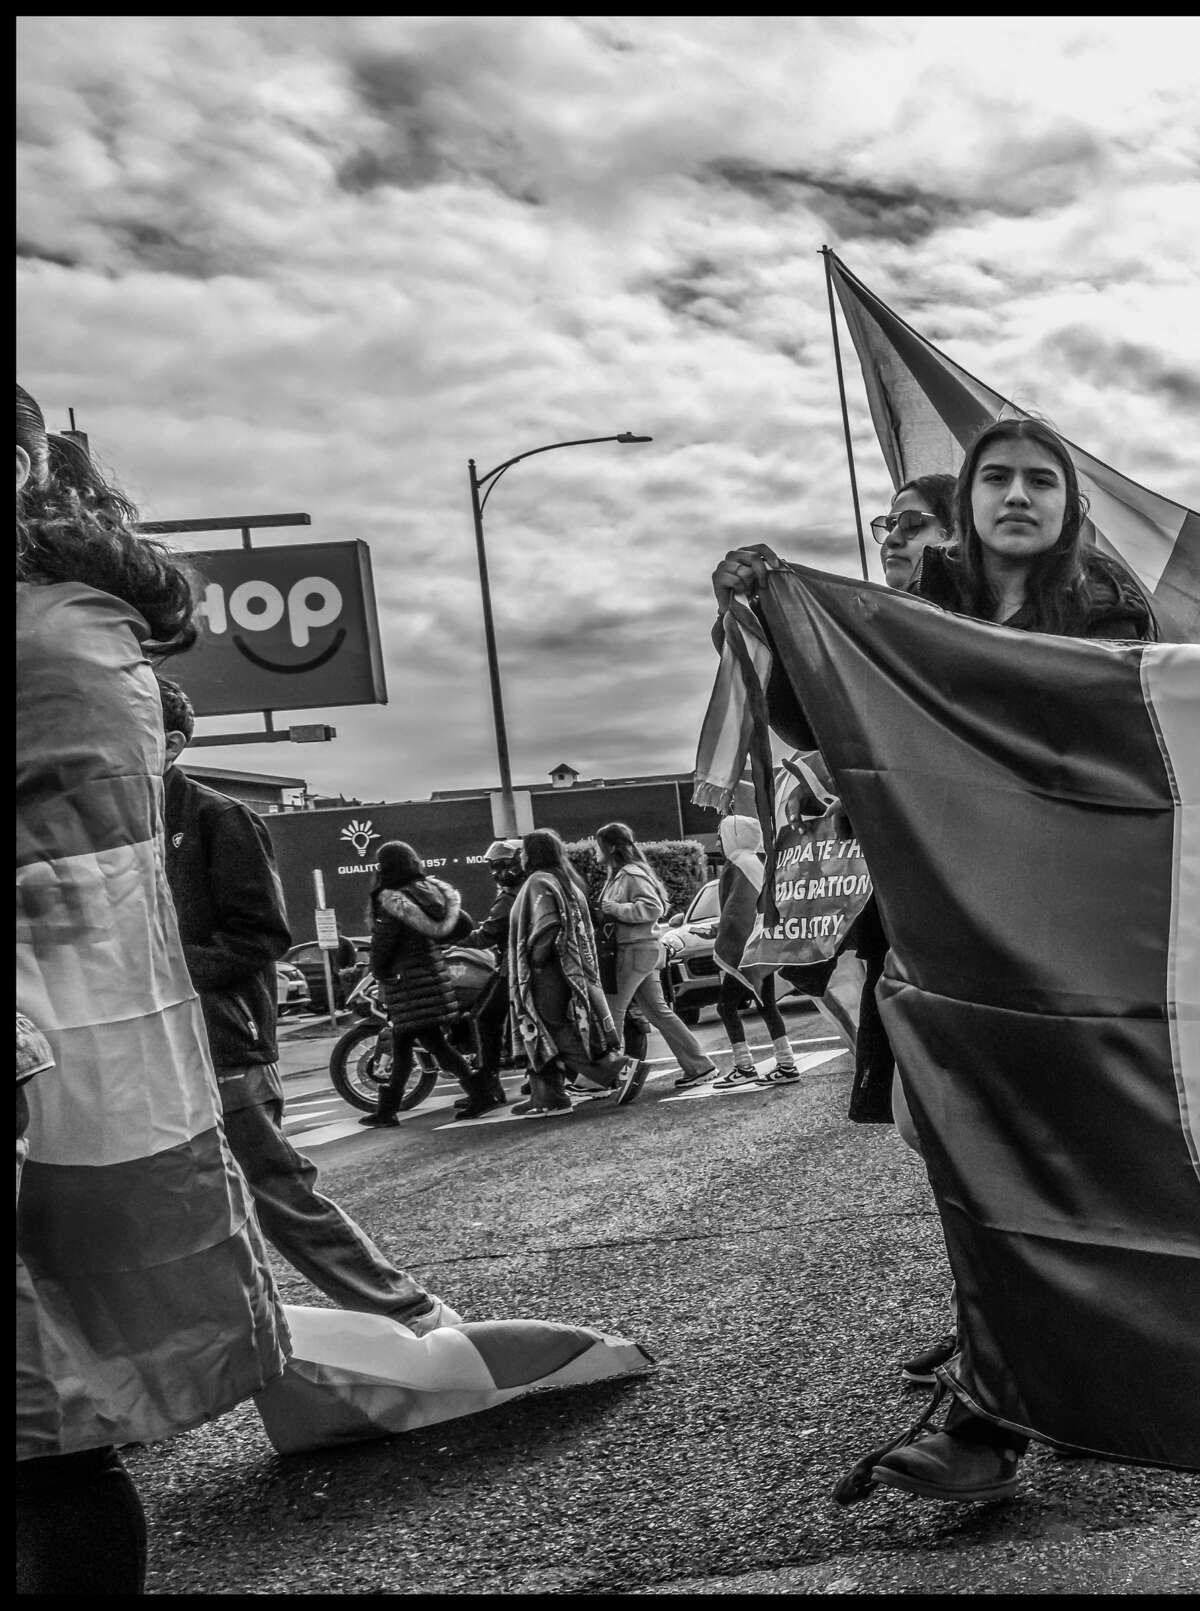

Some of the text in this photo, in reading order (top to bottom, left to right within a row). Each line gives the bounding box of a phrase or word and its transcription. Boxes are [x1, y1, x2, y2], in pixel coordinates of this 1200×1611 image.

[420, 858, 447, 868] 1957
[776, 838, 865, 870] UPDATE TH
